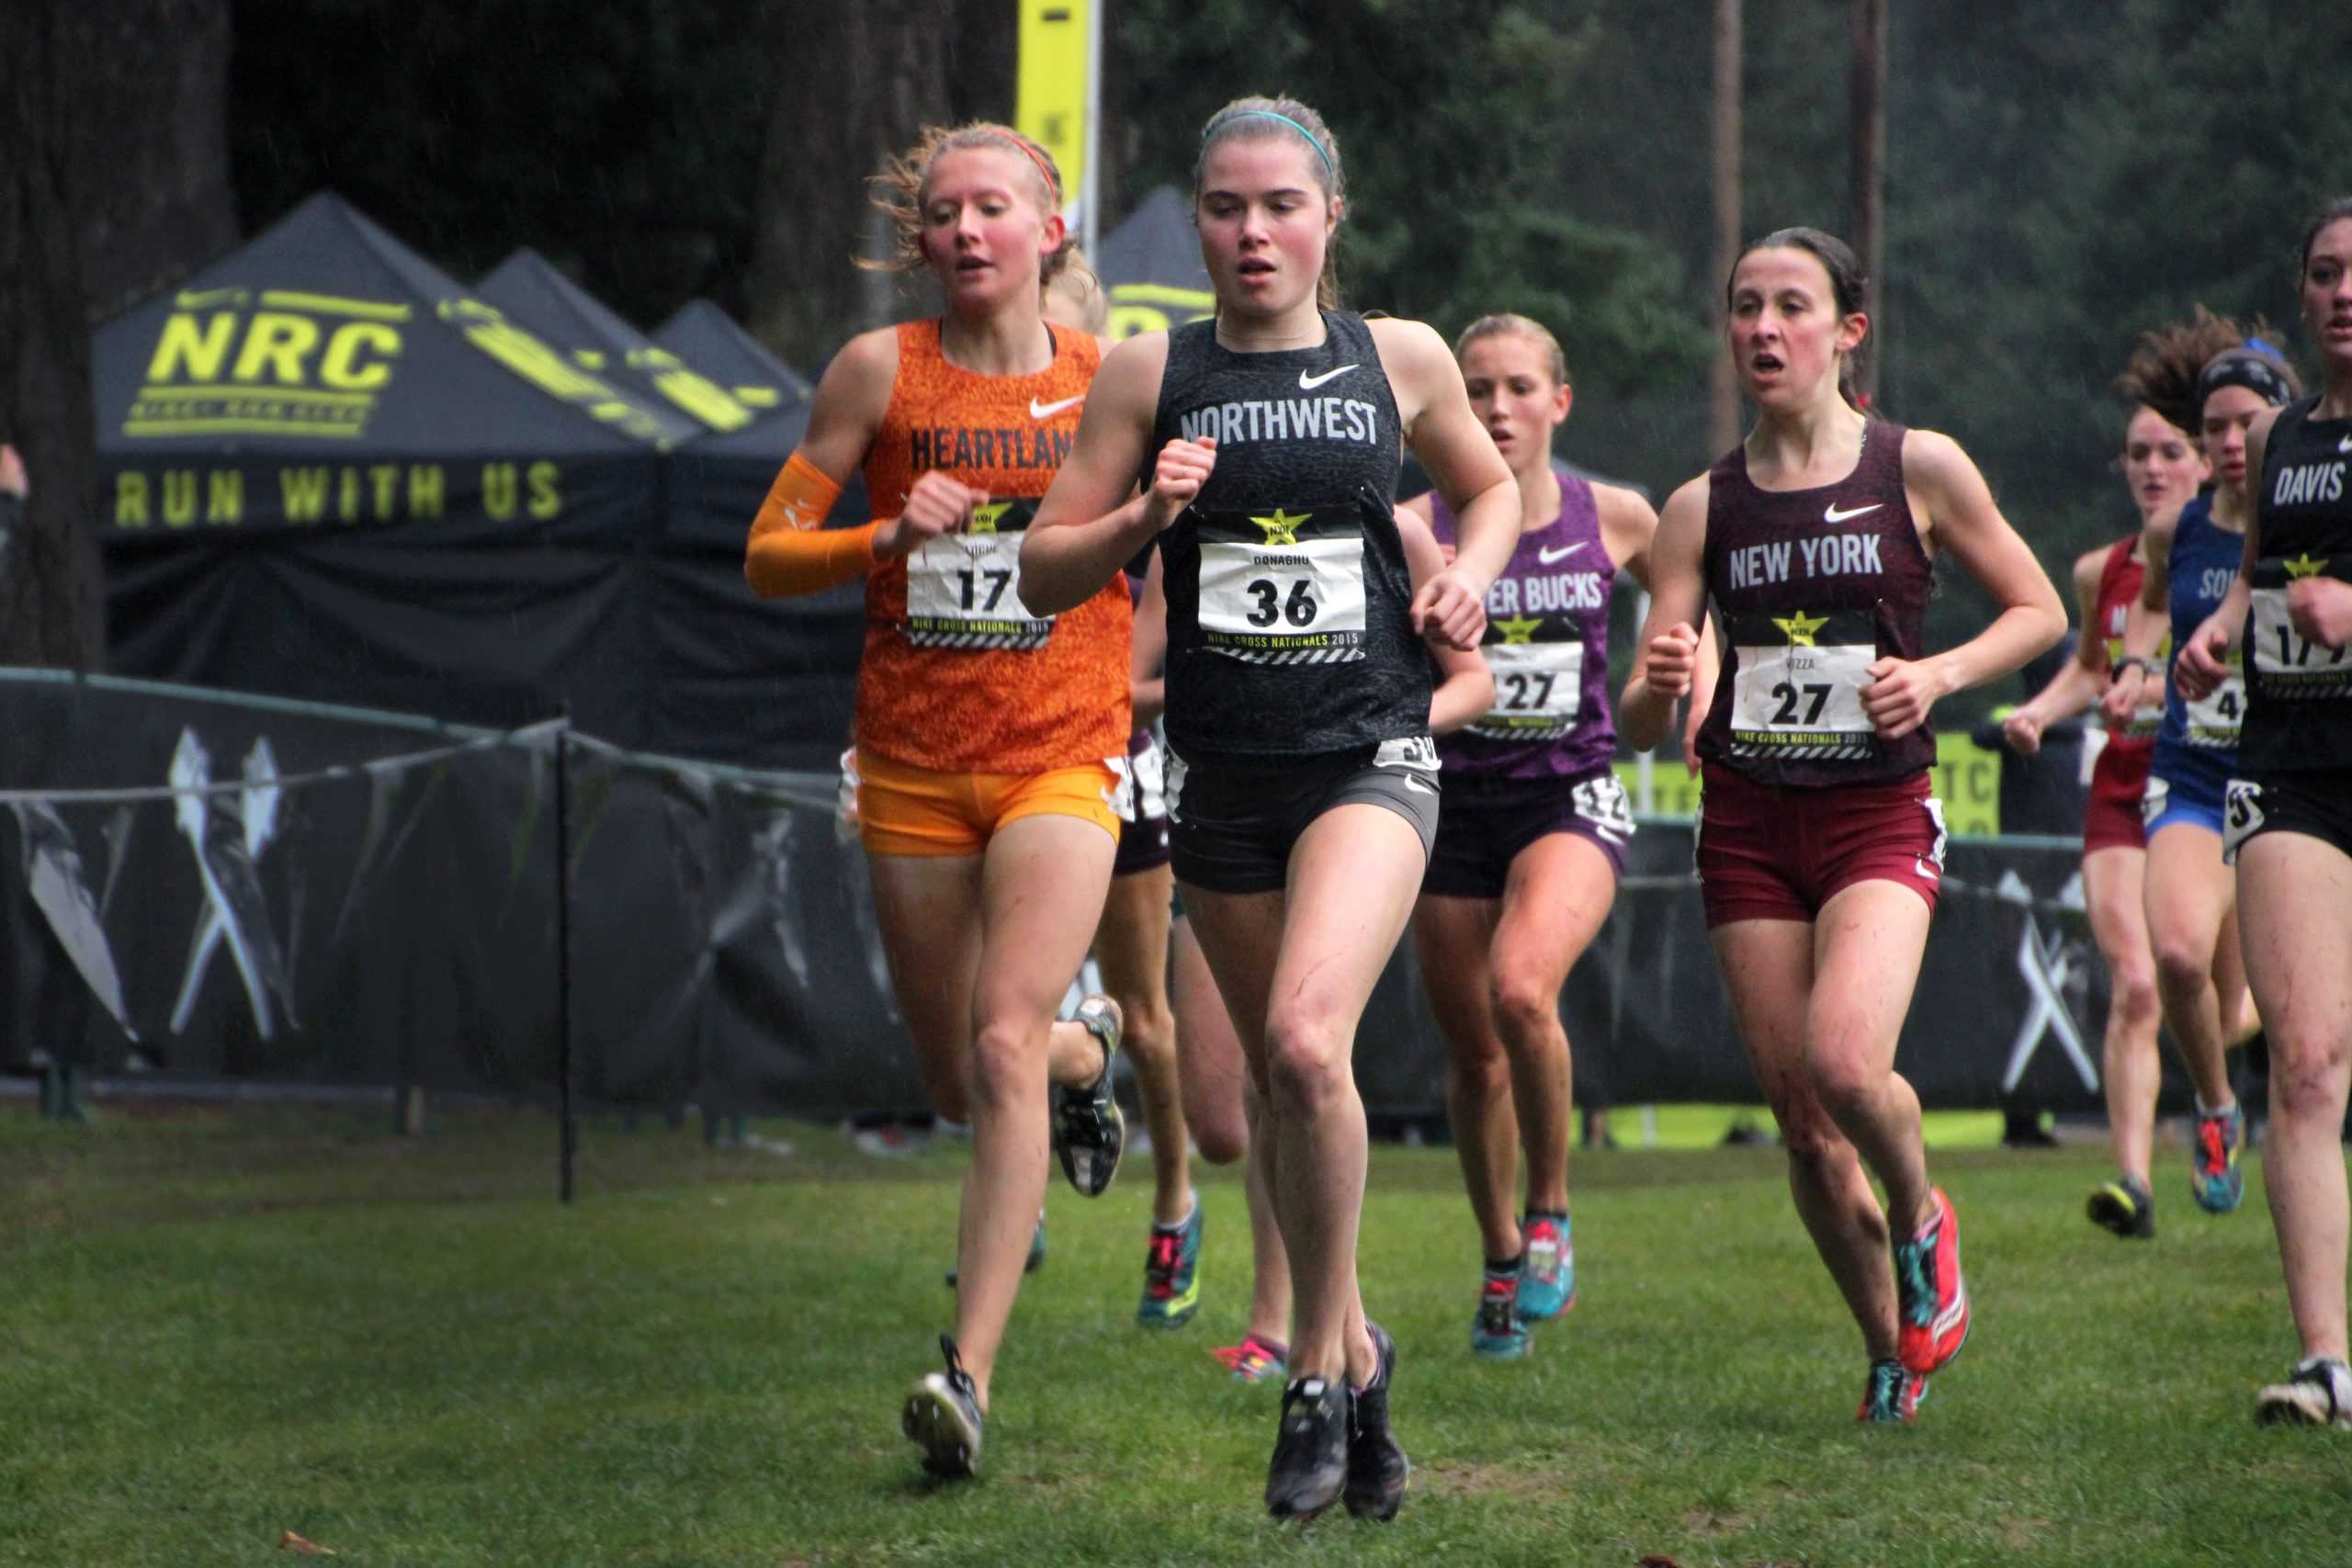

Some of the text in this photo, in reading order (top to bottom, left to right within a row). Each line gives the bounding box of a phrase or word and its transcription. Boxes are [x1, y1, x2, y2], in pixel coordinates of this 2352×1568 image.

[148, 311, 402, 389] NRC
[1181, 397, 1377, 446] NORTHWEST
[910, 426, 1072, 470] HEARTLAN
[116, 461, 561, 528] RUN WITH US
[2274, 461, 2346, 506] DAVIS
[1253, 555, 1309, 567] DONAGHU
[1730, 534, 1883, 591] NEW YORK
[957, 570, 1012, 612] 17
[1246, 579, 1317, 627] 36
[1524, 572, 1603, 613] BUCKS
[1272, 635, 1329, 648] NATIONALS
[1332, 632, 1359, 644] 2015
[1770, 682, 1834, 726] 27
